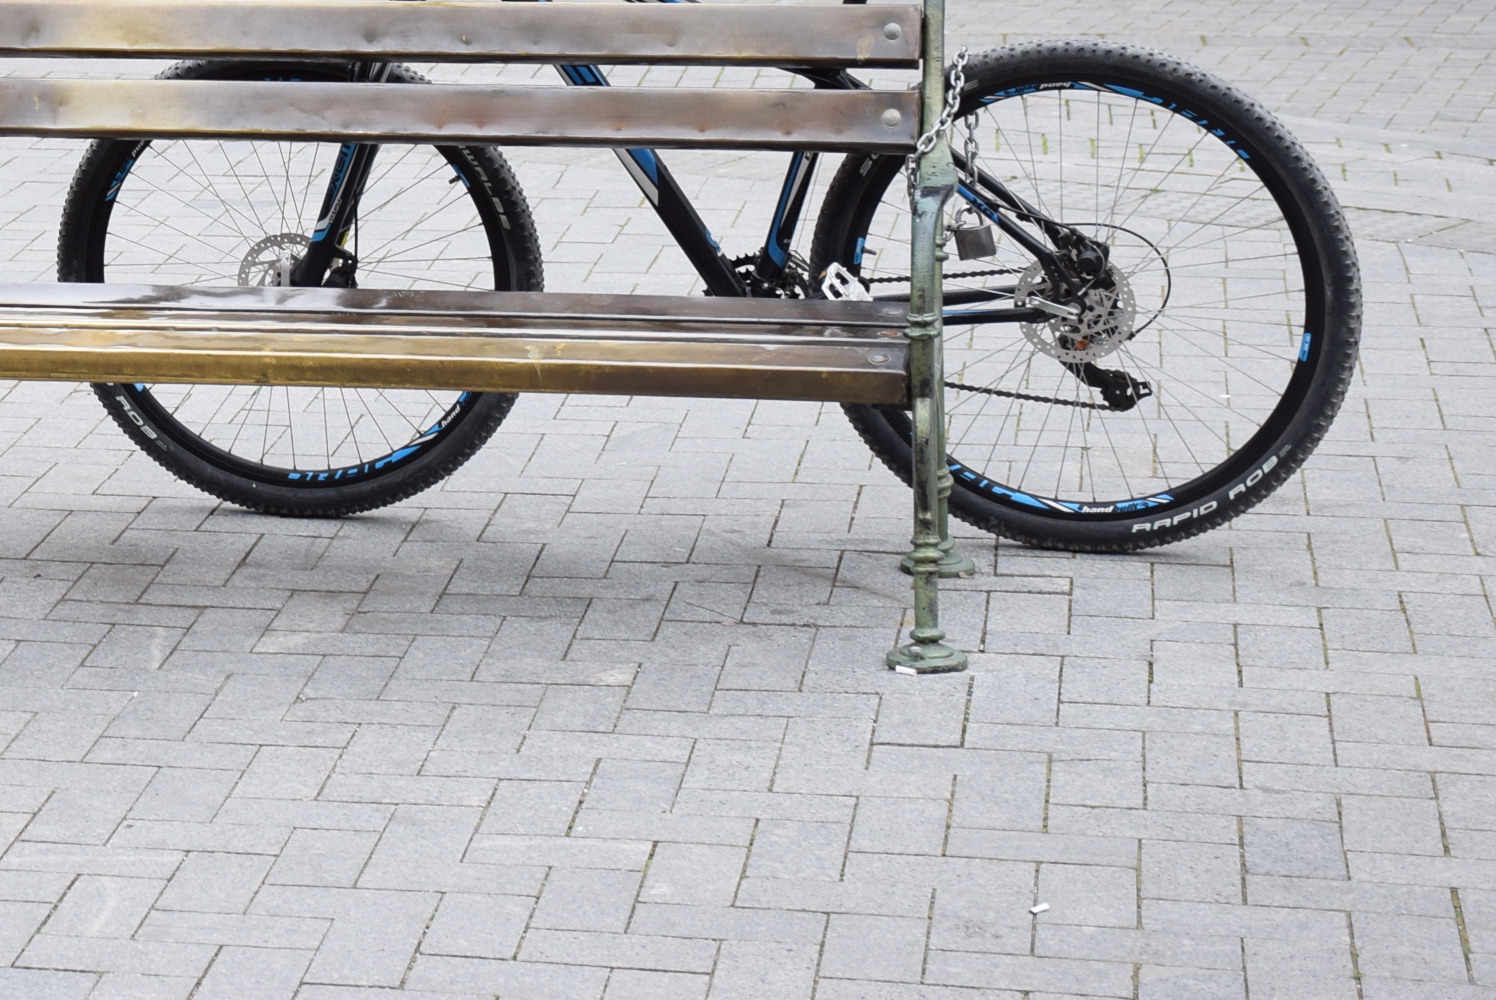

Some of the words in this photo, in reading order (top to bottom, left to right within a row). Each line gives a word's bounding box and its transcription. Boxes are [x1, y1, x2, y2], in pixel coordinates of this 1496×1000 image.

[459, 146, 511, 231] WALBE
[115, 395, 158, 440] ROB
[1131, 500, 1219, 534] RAPID
[1228, 455, 1280, 501] ROB
